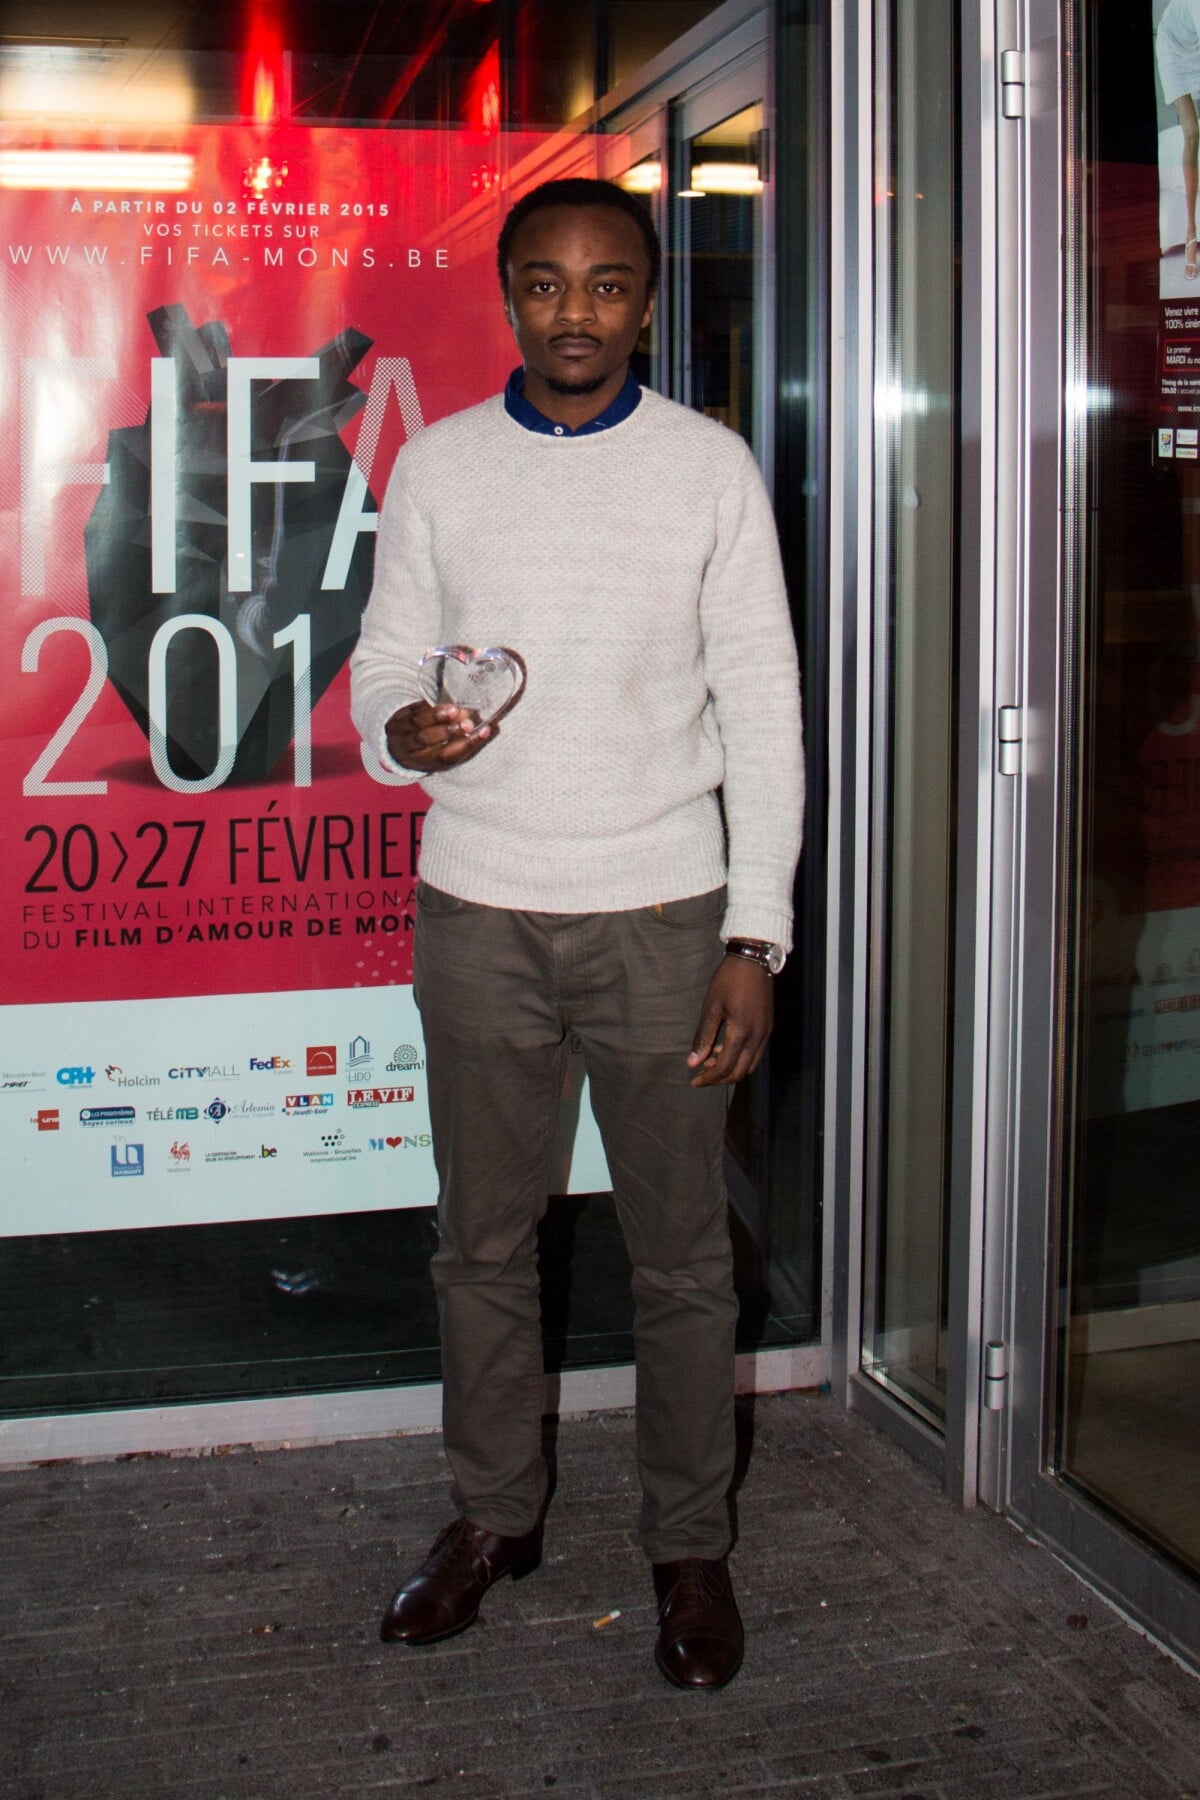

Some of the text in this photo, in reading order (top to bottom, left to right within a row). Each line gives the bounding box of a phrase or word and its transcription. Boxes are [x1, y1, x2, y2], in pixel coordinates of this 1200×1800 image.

[70, 197, 389, 216] À PARTIR DU 02 FÉVRIER 2015
[143, 223, 319, 238] VOS TICKETS SUR
[8, 245, 449, 269] WWW.FIFA-MONS.BE
[1164, 319, 1184, 329] 100%
[20, 356, 426, 596] FIFA
[21, 613, 424, 797] 201
[23, 889, 416, 924] FESTIVAL INTERNATIONA
[23, 930, 61, 950] DU
[75, 927, 142, 947] FILM
[156, 919, 294, 945] D'AMOUR
[307, 917, 342, 937] DE
[249, 1056, 291, 1071] FedEx
[386, 1060, 425, 1072] dream!
[118, 1075, 161, 1088] Holcim
[287, 1094, 333, 1107] VLAN
[348, 1086, 413, 1105] LE VIF
